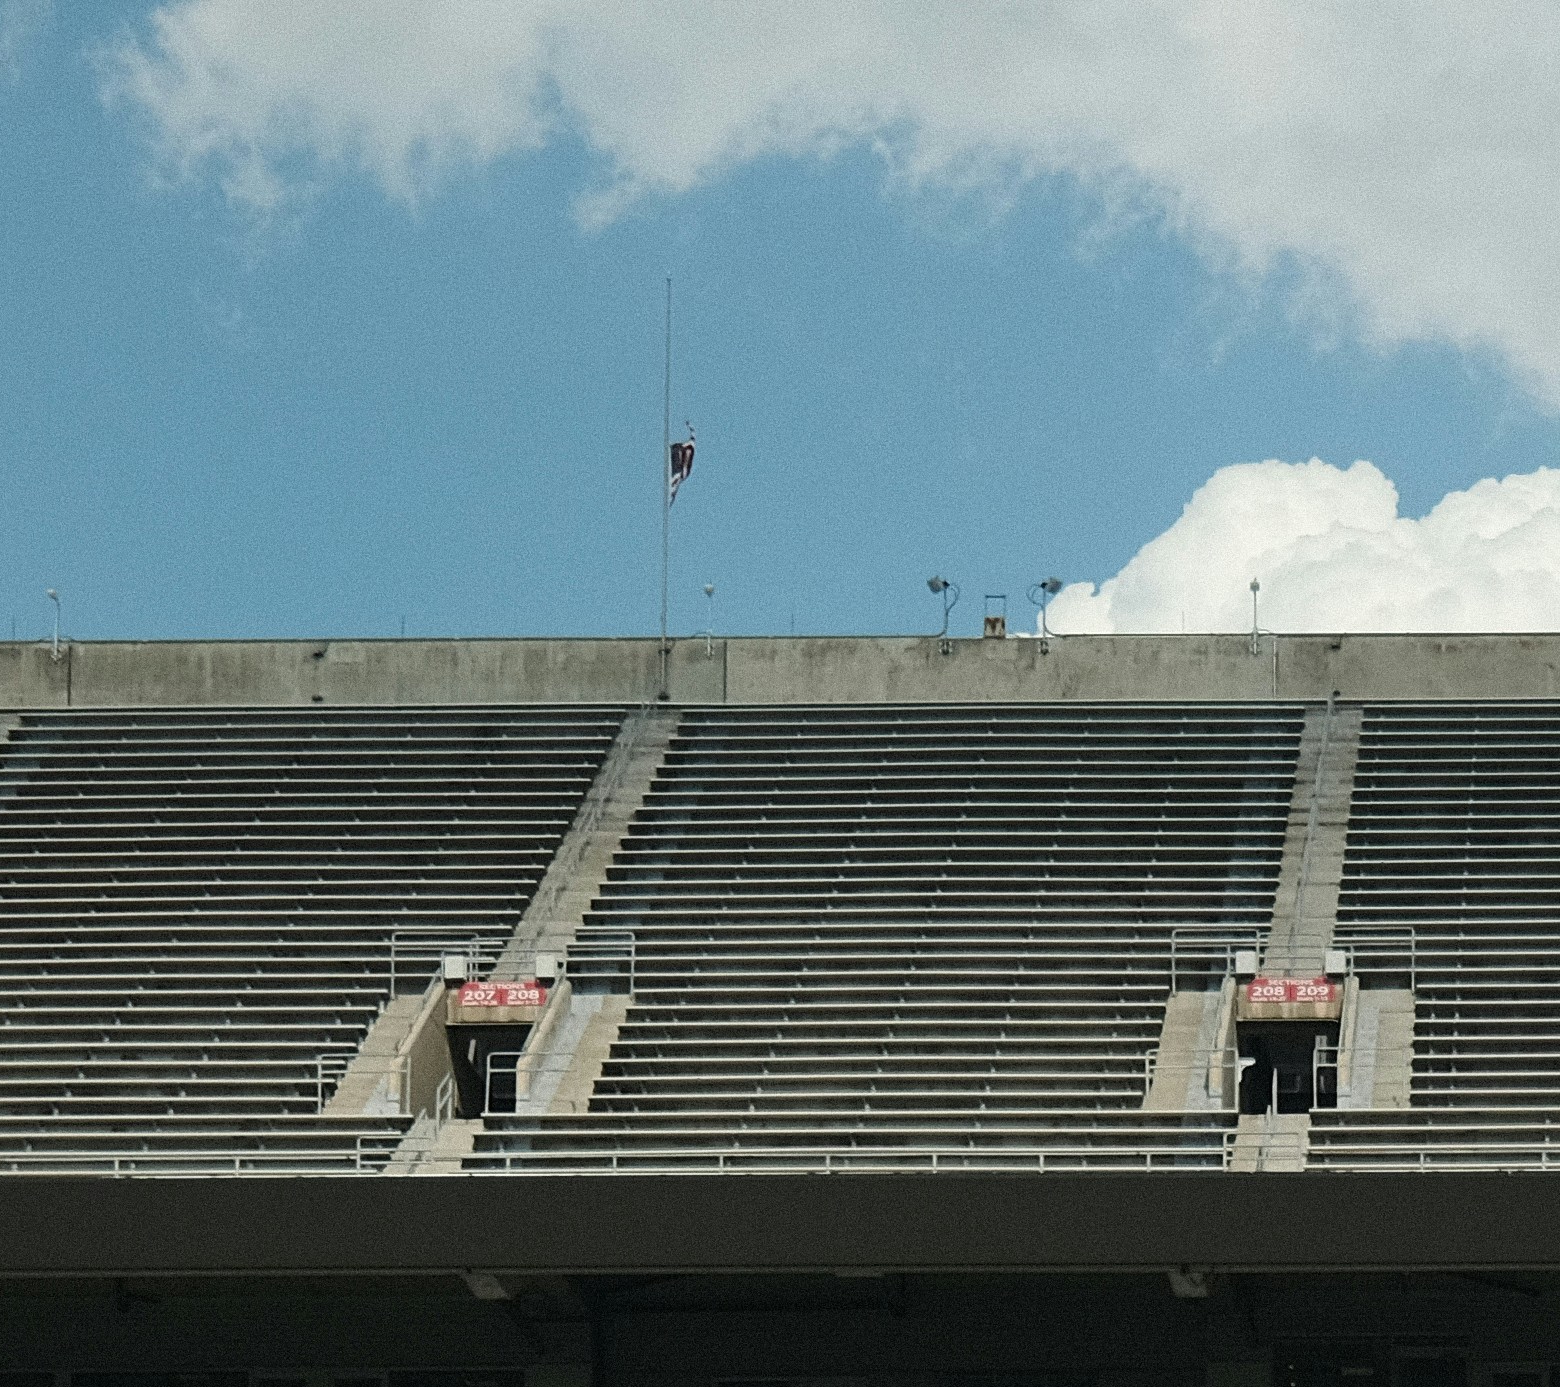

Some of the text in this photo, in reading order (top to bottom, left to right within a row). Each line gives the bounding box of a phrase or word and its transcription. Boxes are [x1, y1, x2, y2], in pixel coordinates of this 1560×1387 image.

[464, 990, 539, 1000] 207 208
[1252, 986, 1329, 996] 208 209
